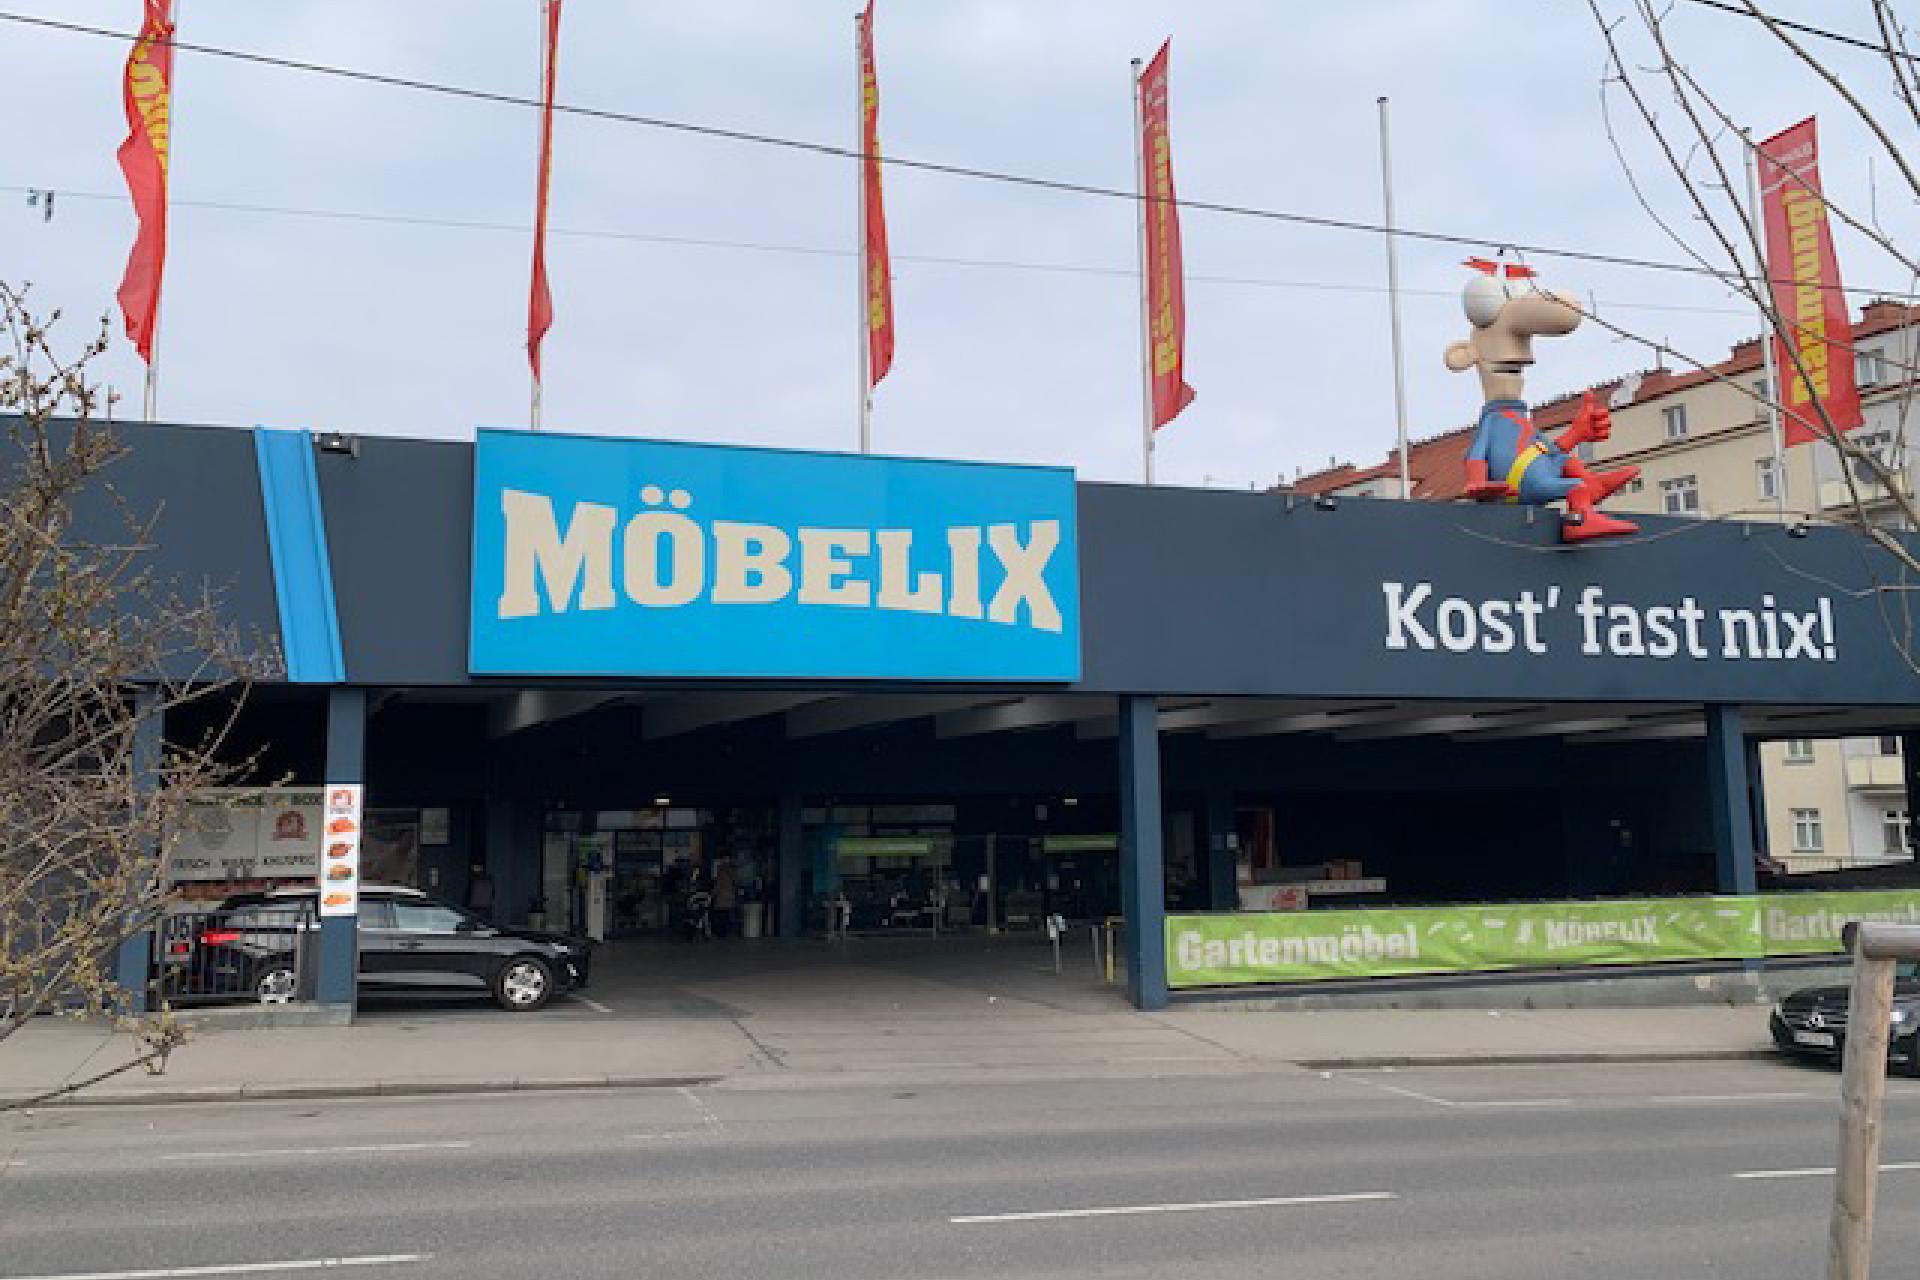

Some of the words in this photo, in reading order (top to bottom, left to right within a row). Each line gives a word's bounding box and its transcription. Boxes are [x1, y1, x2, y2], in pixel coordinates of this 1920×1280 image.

[498, 484, 1062, 633] MÖBELIX
[1576, 586, 1708, 659] fast
[1719, 594, 1837, 661] nix!
[1177, 924, 1419, 971] Gartenmöbel
